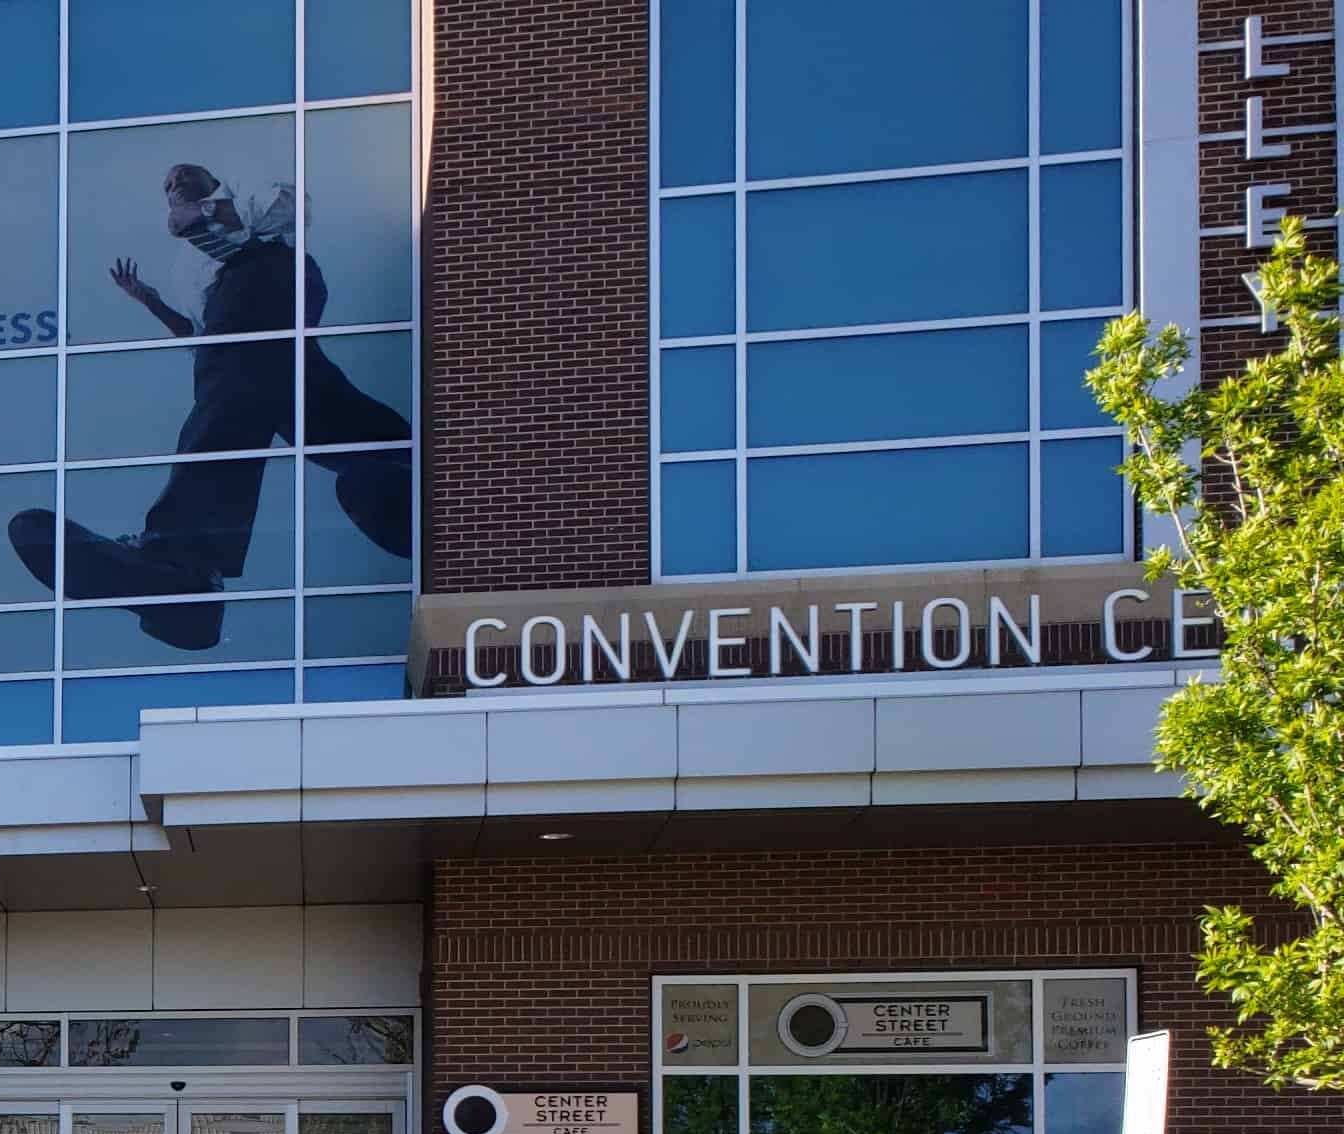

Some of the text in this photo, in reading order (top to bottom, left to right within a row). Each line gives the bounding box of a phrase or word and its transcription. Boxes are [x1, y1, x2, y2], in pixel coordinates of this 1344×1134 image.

[465, 593, 1041, 687] CONVENTION
[873, 1004, 950, 1017] CENTER
[875, 1019, 949, 1032] STREET
[893, 1037, 931, 1046] CAFE
[534, 1095, 608, 1108] CENTER
[535, 1110, 606, 1122] STREET
